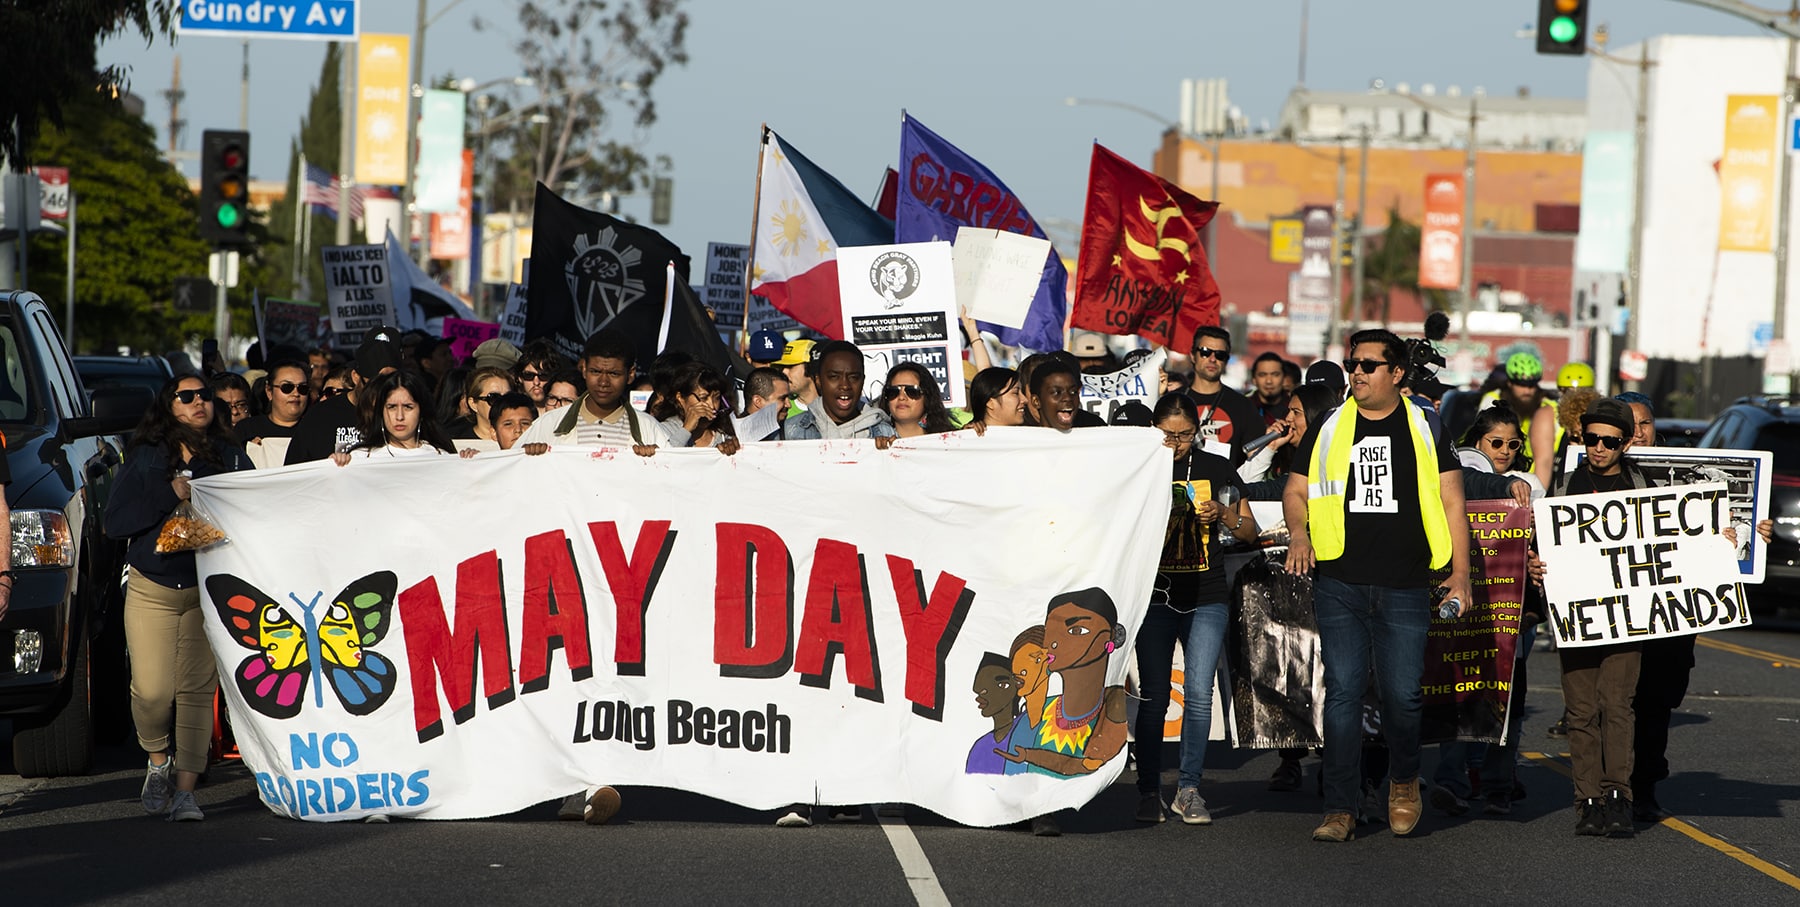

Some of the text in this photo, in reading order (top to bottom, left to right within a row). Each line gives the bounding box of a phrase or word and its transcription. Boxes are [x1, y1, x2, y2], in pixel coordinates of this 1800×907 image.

[188, 0, 347, 30] Gundry Av
[341, 250, 363, 262] MAS
[364, 249, 384, 260] ICE!
[873, 253, 890, 269] BEACH
[890, 252, 907, 260] GRAY
[332, 264, 384, 287] ¡ALTO
[345, 288, 374, 302] A LAS
[337, 303, 387, 318] REDADAS!
[450, 323, 481, 340] CODE
[501, 328, 519, 341] NOT
[764, 336, 774, 349] LA
[897, 352, 942, 364] FIGHT
[336, 426, 346, 435] SO
[1359, 446, 1387, 463] RISE
[1360, 464, 1387, 486] UP
[1363, 488, 1383, 507] AS
[1467, 512, 1507, 523] TECT
[1550, 489, 1728, 546] PROTECT
[1470, 528, 1532, 539] TLANDS
[1480, 547, 1498, 556] To:
[1600, 542, 1682, 589] THE
[1494, 576, 1515, 584] lines
[1549, 581, 1749, 642] WETLANDS!
[1431, 617, 1457, 625] ssions
[398, 520, 976, 743] MAY DAY
[1427, 630, 1451, 639] oring
[1453, 626, 1500, 637] Indigenous
[1443, 648, 1499, 662] KEEP IT
[1464, 666, 1480, 675] IN
[1421, 684, 1451, 695] THE
[573, 699, 791, 754] Long Beach
[289, 732, 359, 770] NO
[256, 769, 430, 815] BORDERS
